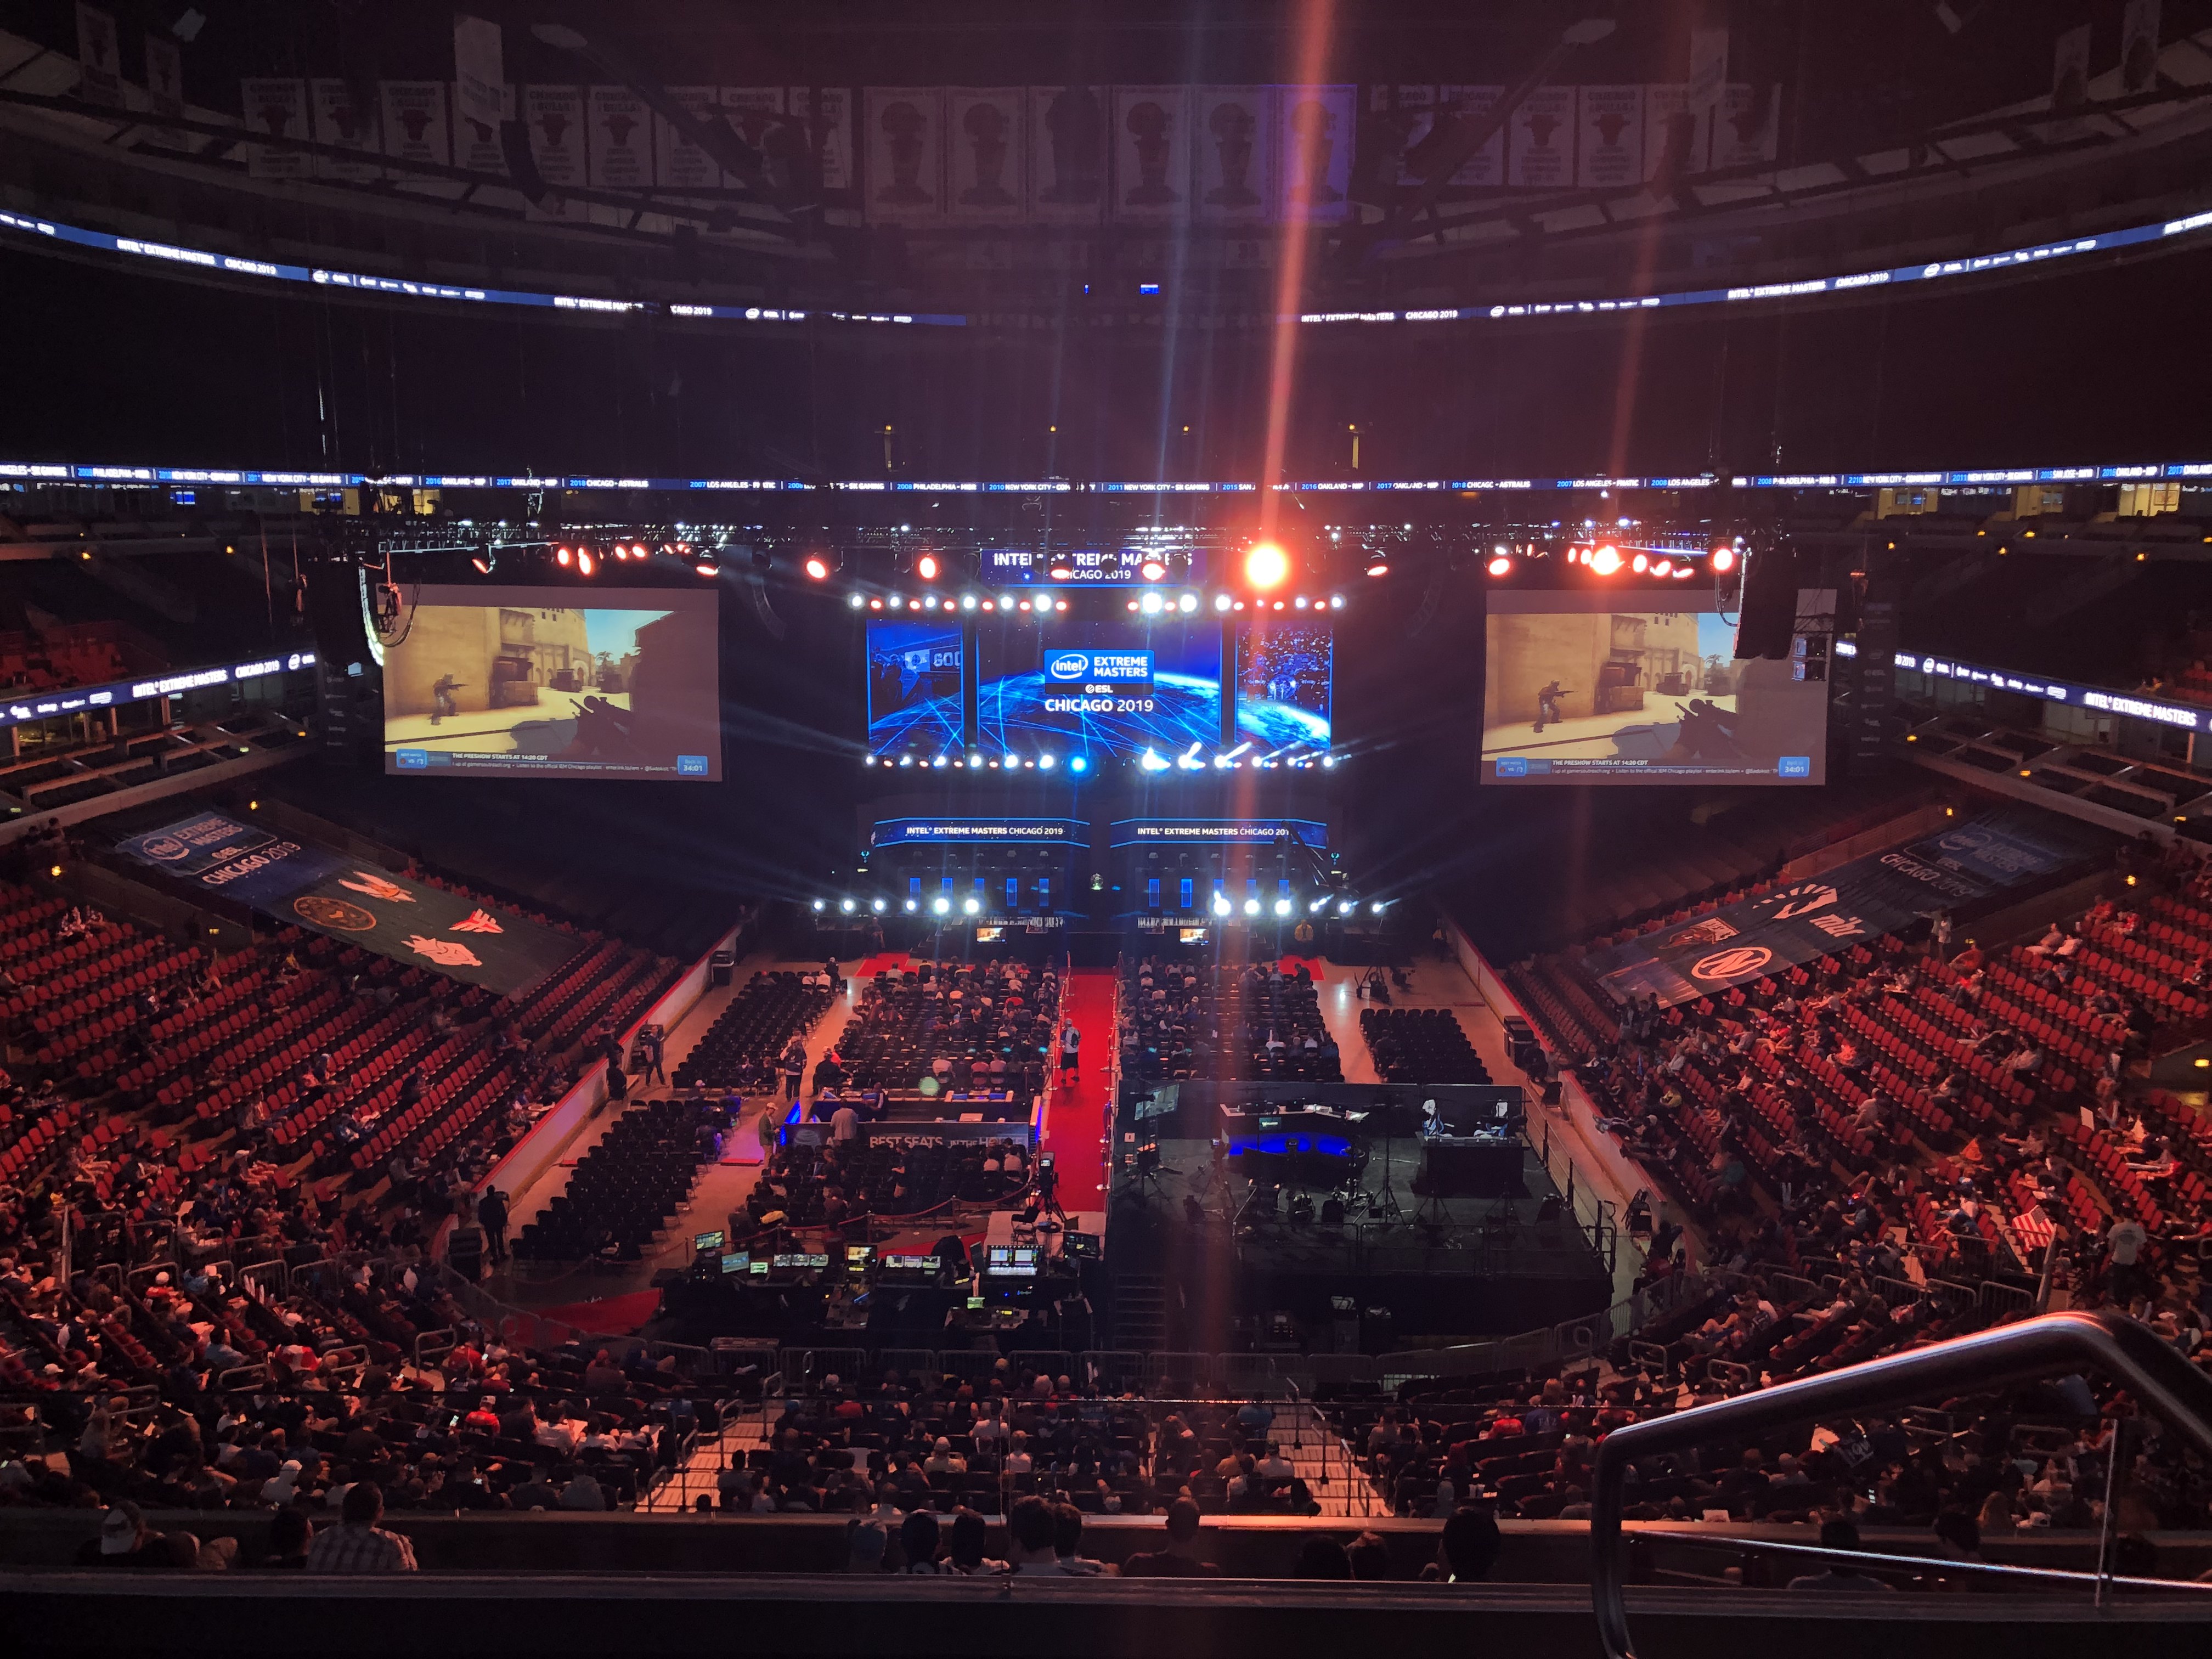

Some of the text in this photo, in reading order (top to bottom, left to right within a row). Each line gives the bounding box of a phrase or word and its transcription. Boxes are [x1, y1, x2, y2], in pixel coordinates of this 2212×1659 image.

[257, 264, 276, 275] 2019
[1870, 273, 1889, 283] 2019
[693, 307, 713, 315] 2019
[1406, 311, 1438, 320] CHICAGO
[1438, 309, 1458, 319] 2019
[1104, 569, 1132, 580] 2019
[1056, 656, 1148, 672] intel EXTREME
[1093, 667, 1148, 678] MASTERS
[1095, 685, 1114, 693] ESL
[1045, 699, 1154, 712] CHICAGO 2019
[2152, 705, 2197, 726] MASTERS
[934, 827, 970, 835] EXTREME
[971, 827, 1007, 835] MASTERS
[1008, 827, 1043, 836] CHICAGO
[1164, 827, 1201, 836] EXTREME
[1202, 827, 1238, 836] MASTERS
[1239, 827, 1274, 836] CHICAGO
[202, 842, 302, 884] CHICAGO 2019
[1880, 854, 1941, 881] CHICAGO
[1931, 878, 1974, 898] 2019
[869, 1136, 902, 1148] BEST
[904, 1136, 943, 1149] SEATS
